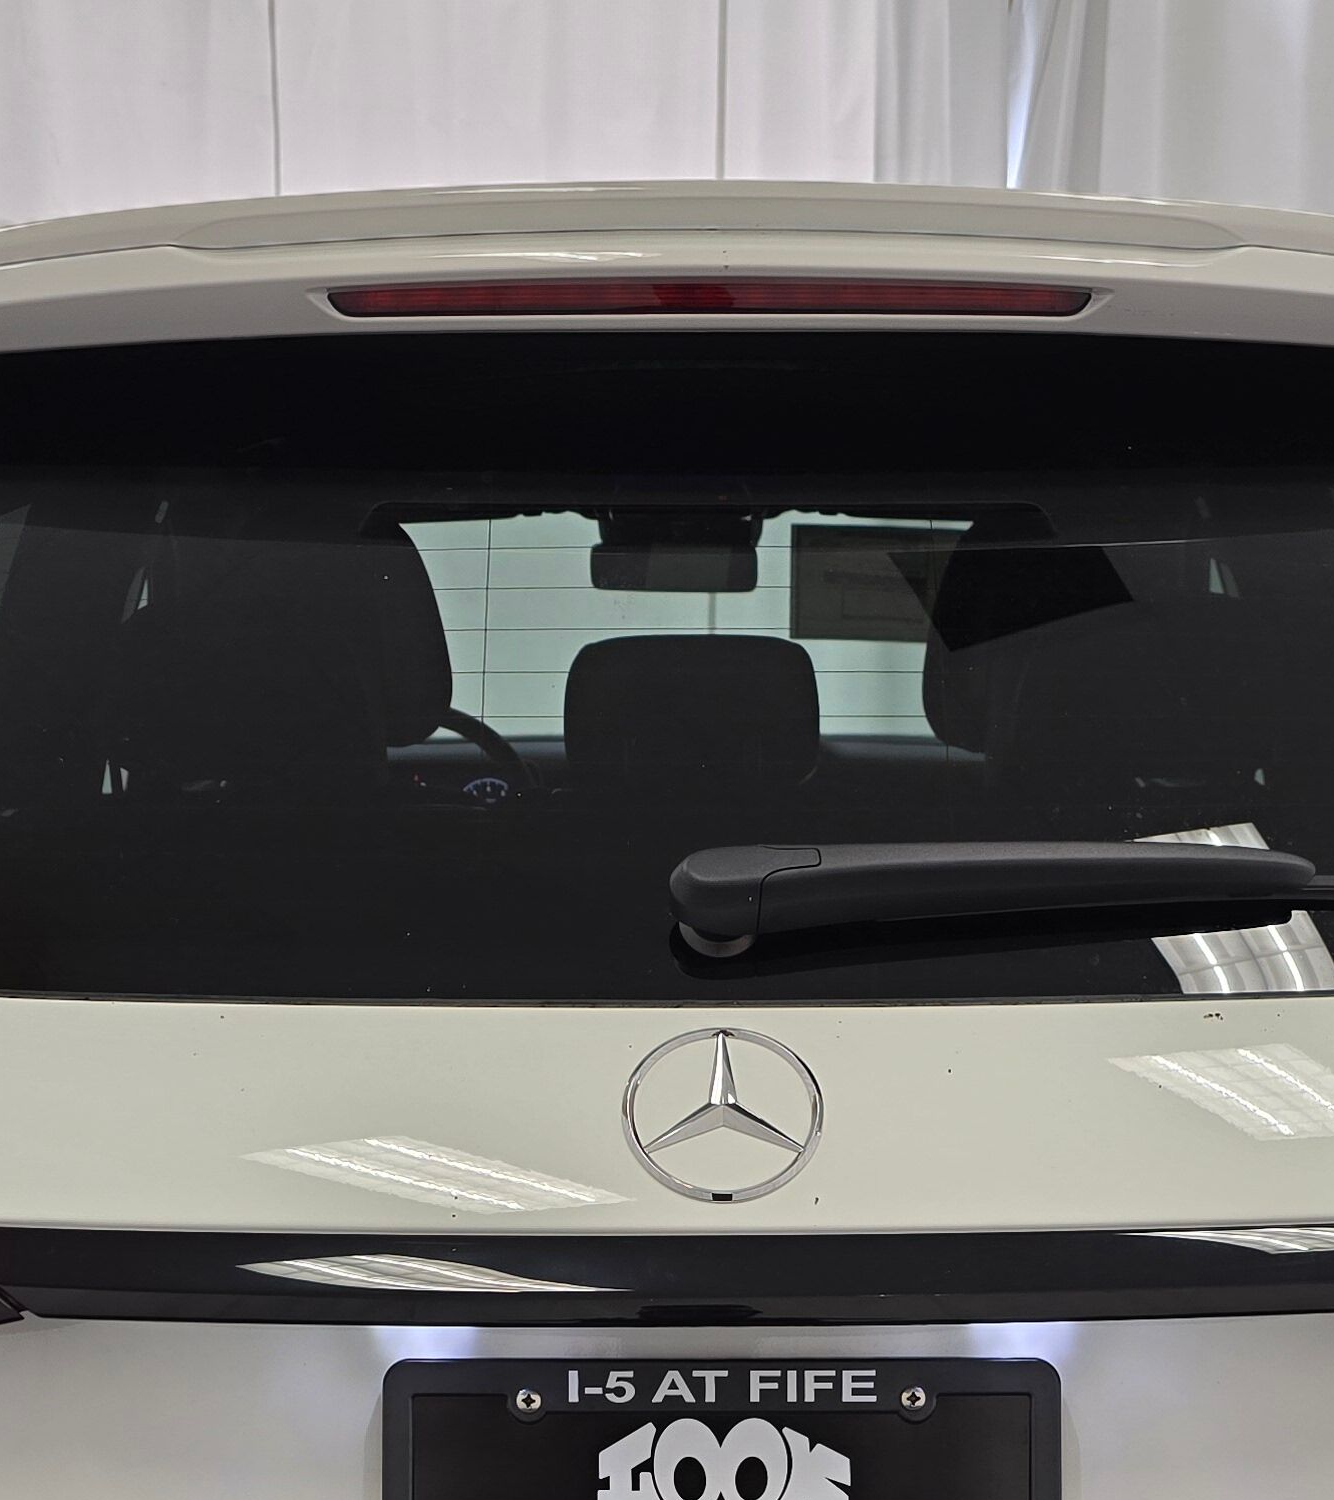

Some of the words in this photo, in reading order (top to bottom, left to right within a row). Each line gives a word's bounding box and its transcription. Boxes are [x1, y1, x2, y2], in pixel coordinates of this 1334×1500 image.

[568, 1370, 635, 1404] I-5
[651, 1370, 728, 1403] AT
[749, 1369, 878, 1403] FIFE
